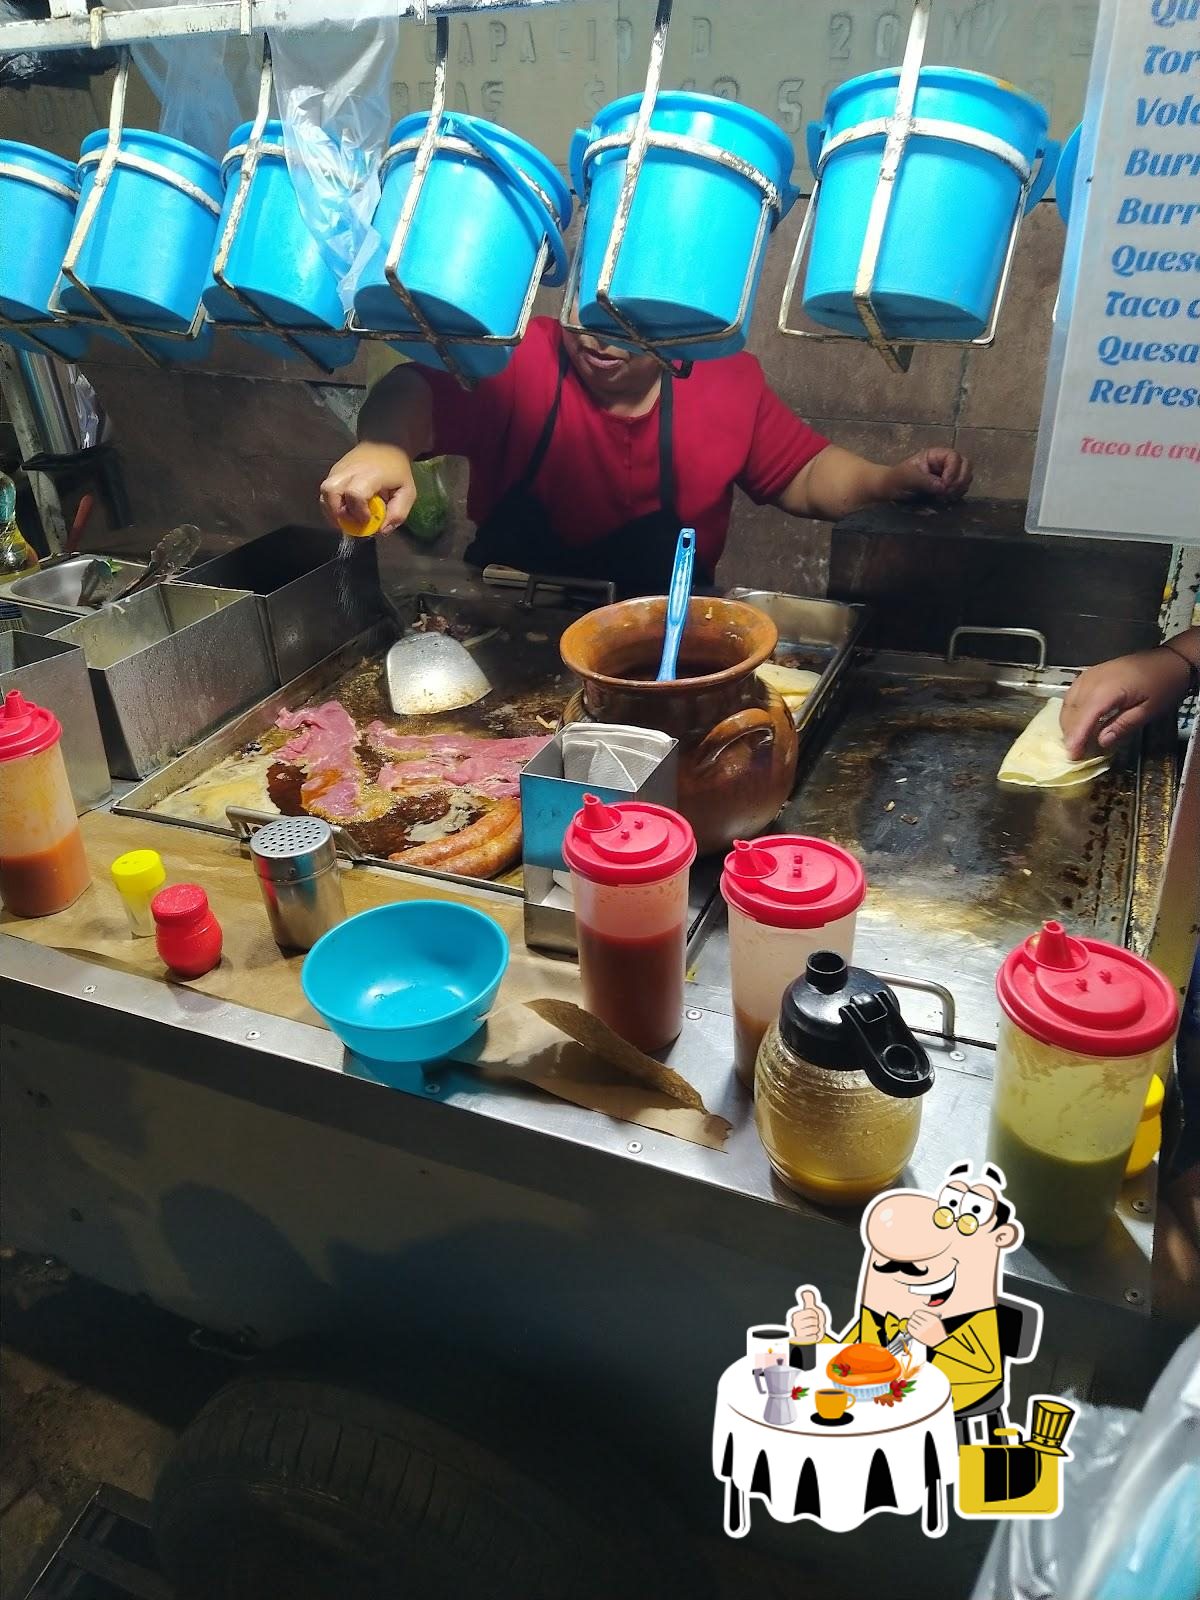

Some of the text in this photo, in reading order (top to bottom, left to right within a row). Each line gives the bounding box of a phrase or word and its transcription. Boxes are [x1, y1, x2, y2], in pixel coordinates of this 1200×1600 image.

[1105, 290, 1181, 319] Taco
[1098, 335, 1200, 366] Quesa
[1088, 379, 1200, 408] Refres
[1080, 437, 1131, 456] Taco
[1135, 440, 1163, 458] de
